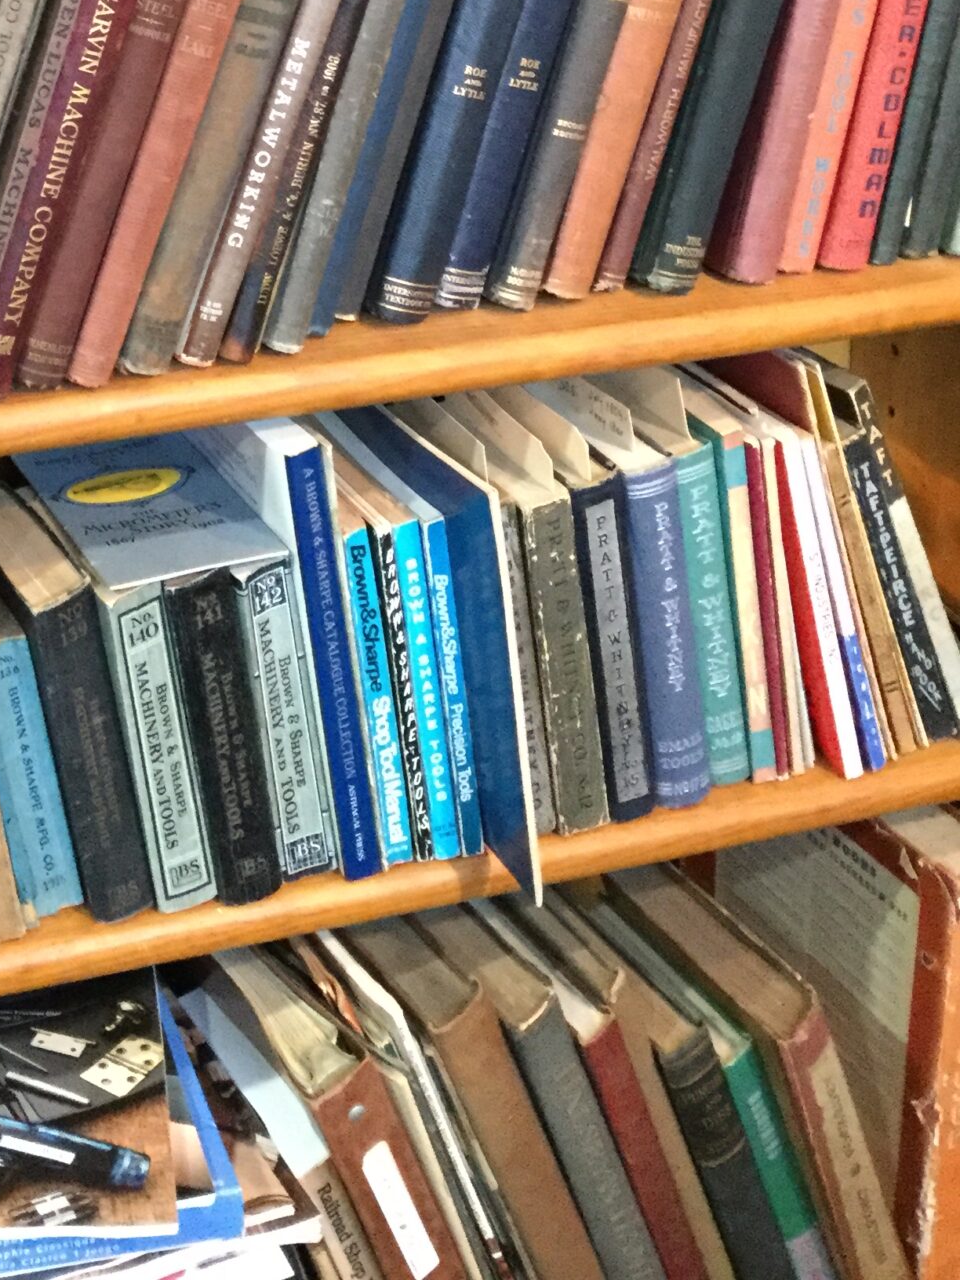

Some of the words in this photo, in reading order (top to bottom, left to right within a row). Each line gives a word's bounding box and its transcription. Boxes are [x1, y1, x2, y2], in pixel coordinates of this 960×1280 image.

[40, 80, 92, 200] MACHINE
[227, 36, 312, 249] METALWORKING
[291, 140, 315, 196] BERLIN
[644, 87, 681, 182] WALWORTH
[2, 205, 54, 328] COMPANY
[860, 401, 893, 488] TAFT
[303, 487, 323, 537] BROWN
[653, 502, 676, 573] PRATT
[689, 485, 716, 565] PRATT
[254, 584, 285, 612] 142
[314, 548, 334, 610] SHARPE
[595, 516, 616, 602] PRATT
[127, 621, 160, 648] 140
[321, 609, 346, 697] CATALOGUE
[660, 599, 687, 694] WHITNEY
[134, 659, 164, 768] MACHINERY
[258, 617, 285, 737] MACHINERY
[405, 557, 426, 623] BROWN
[429, 739, 448, 803] TOOLS
[8, 686, 27, 742] BROWN
[22, 755, 43, 813] SHARPE
[155, 682, 175, 741] BROWN
[170, 759, 189, 819] SHARPE
[274, 736, 287, 773] AND
[278, 653, 296, 710] BROWN
[289, 726, 307, 789] SHARPE
[333, 697, 357, 780] COLLECTION
[372, 694, 392, 747] Shop
[398, 651, 417, 743] SHARPE
[411, 757, 431, 831] TOOLS
[450, 703, 468, 768] Precision
[152, 767, 167, 797] AND
[280, 775, 300, 835] TOOLS
[380, 780, 408, 844] Manual
[457, 767, 472, 803] Tools
[157, 795, 179, 851] TOOLS
[317, 1182, 353, 1244] Railroad
